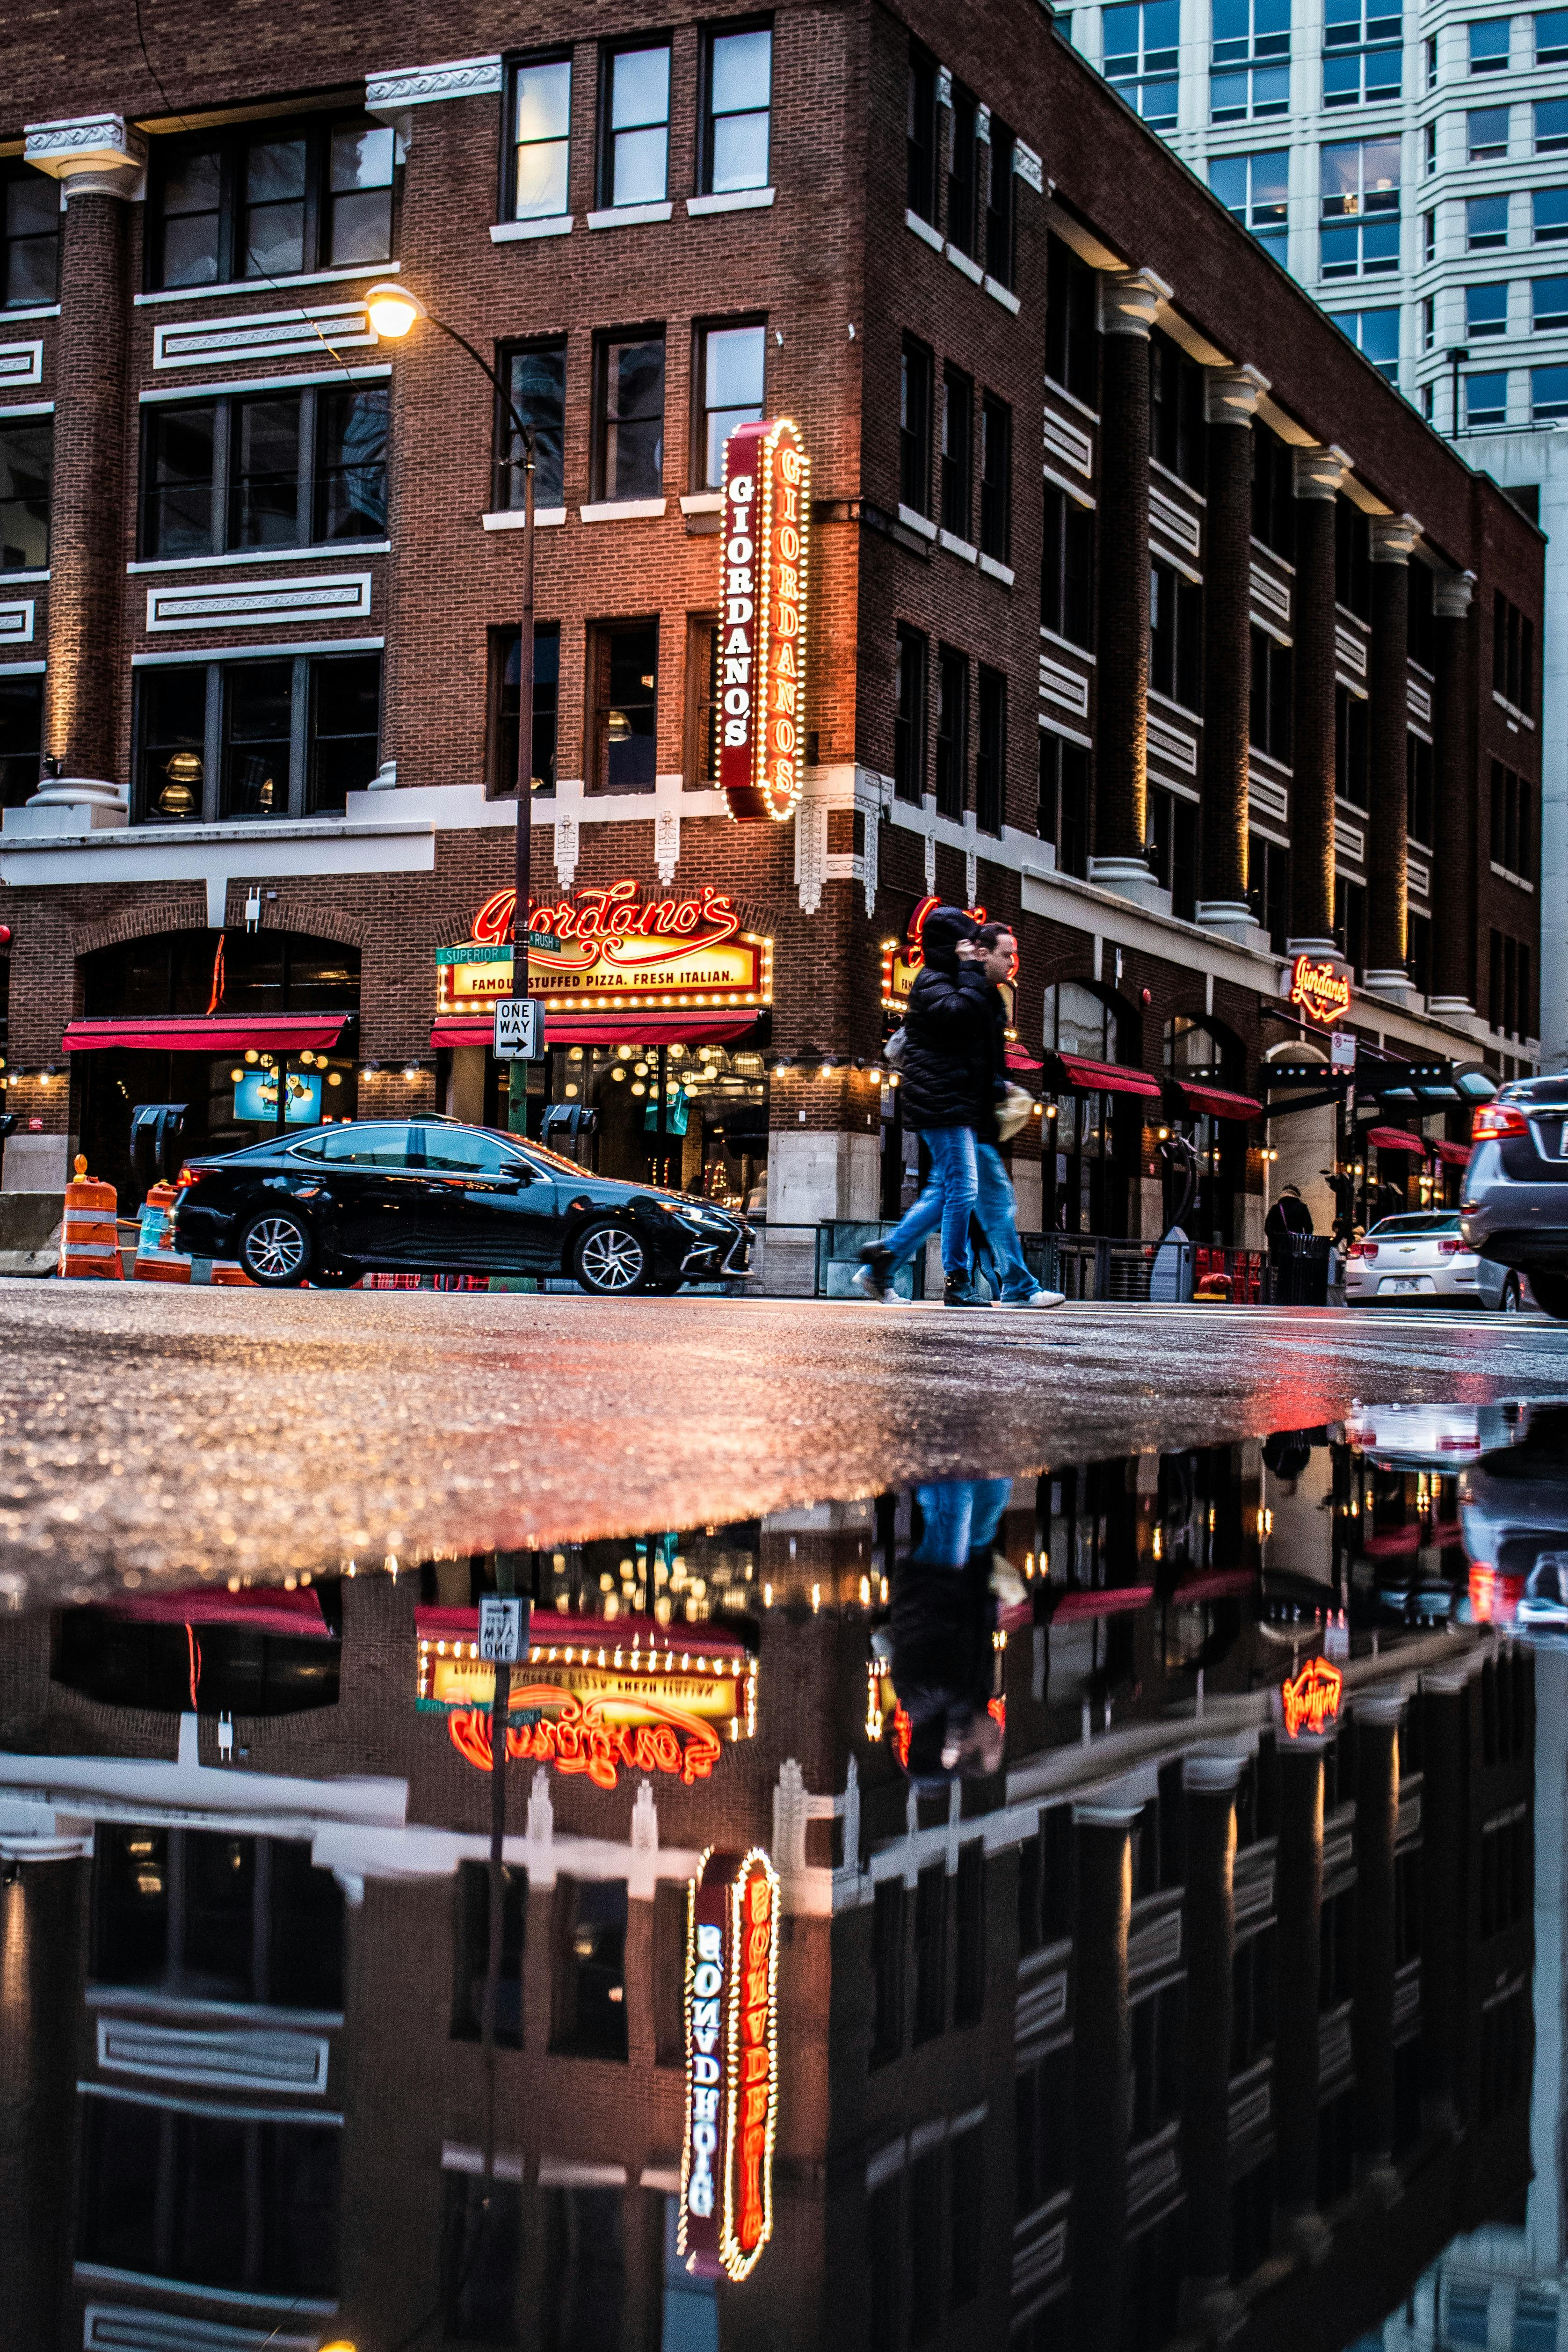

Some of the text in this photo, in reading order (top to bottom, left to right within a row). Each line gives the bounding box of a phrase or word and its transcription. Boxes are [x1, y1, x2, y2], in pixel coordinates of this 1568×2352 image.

[723, 475, 755, 746] GIORDANO'S
[775, 448, 801, 793] GIORDANO'S
[468, 880, 740, 970] Gordano's
[535, 934, 553, 948] RUSH
[555, 939, 560, 947] ST
[446, 948, 498, 962] SUPERIOR
[472, 970, 734, 990] FAMOU STUFFED PIZZA. FRESH ITALIAN.
[501, 1005, 530, 1018] ONE
[500, 1020, 530, 1034] WAY
